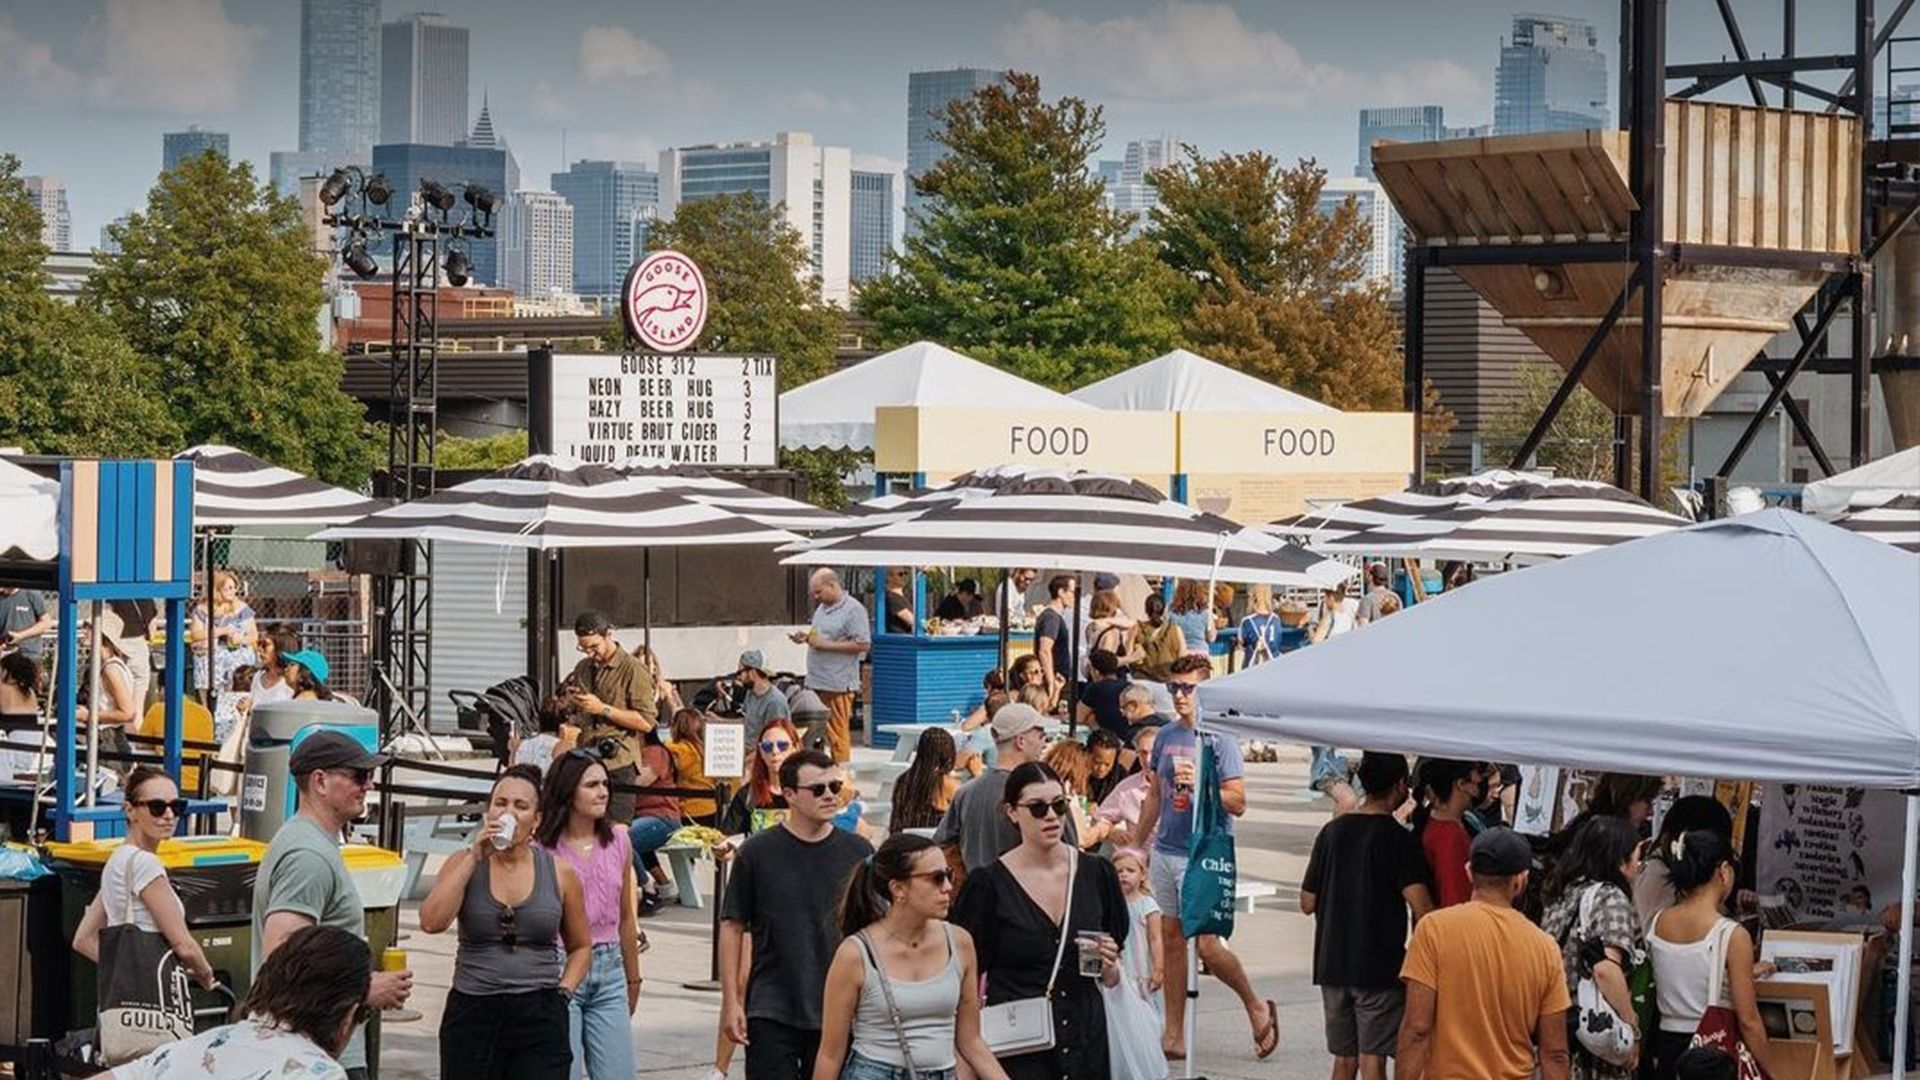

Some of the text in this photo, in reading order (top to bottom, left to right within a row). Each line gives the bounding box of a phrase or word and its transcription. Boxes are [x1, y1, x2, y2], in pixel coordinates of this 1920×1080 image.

[645, 262, 690, 283] GOOSE
[645, 315, 693, 340] ISLAND
[620, 357, 773, 376] GOOSE 312 2 TIX
[588, 378, 751, 398] NEON BEER HUG 3
[588, 400, 751, 420] HAZY BEER HUG 3
[588, 423, 751, 441] VIRTUE BRUT CIDER 2
[1011, 427, 1089, 456] FOOD
[1264, 429, 1335, 457] FOOD
[671, 445, 718, 463] WATER
[743, 445, 748, 462] 1
